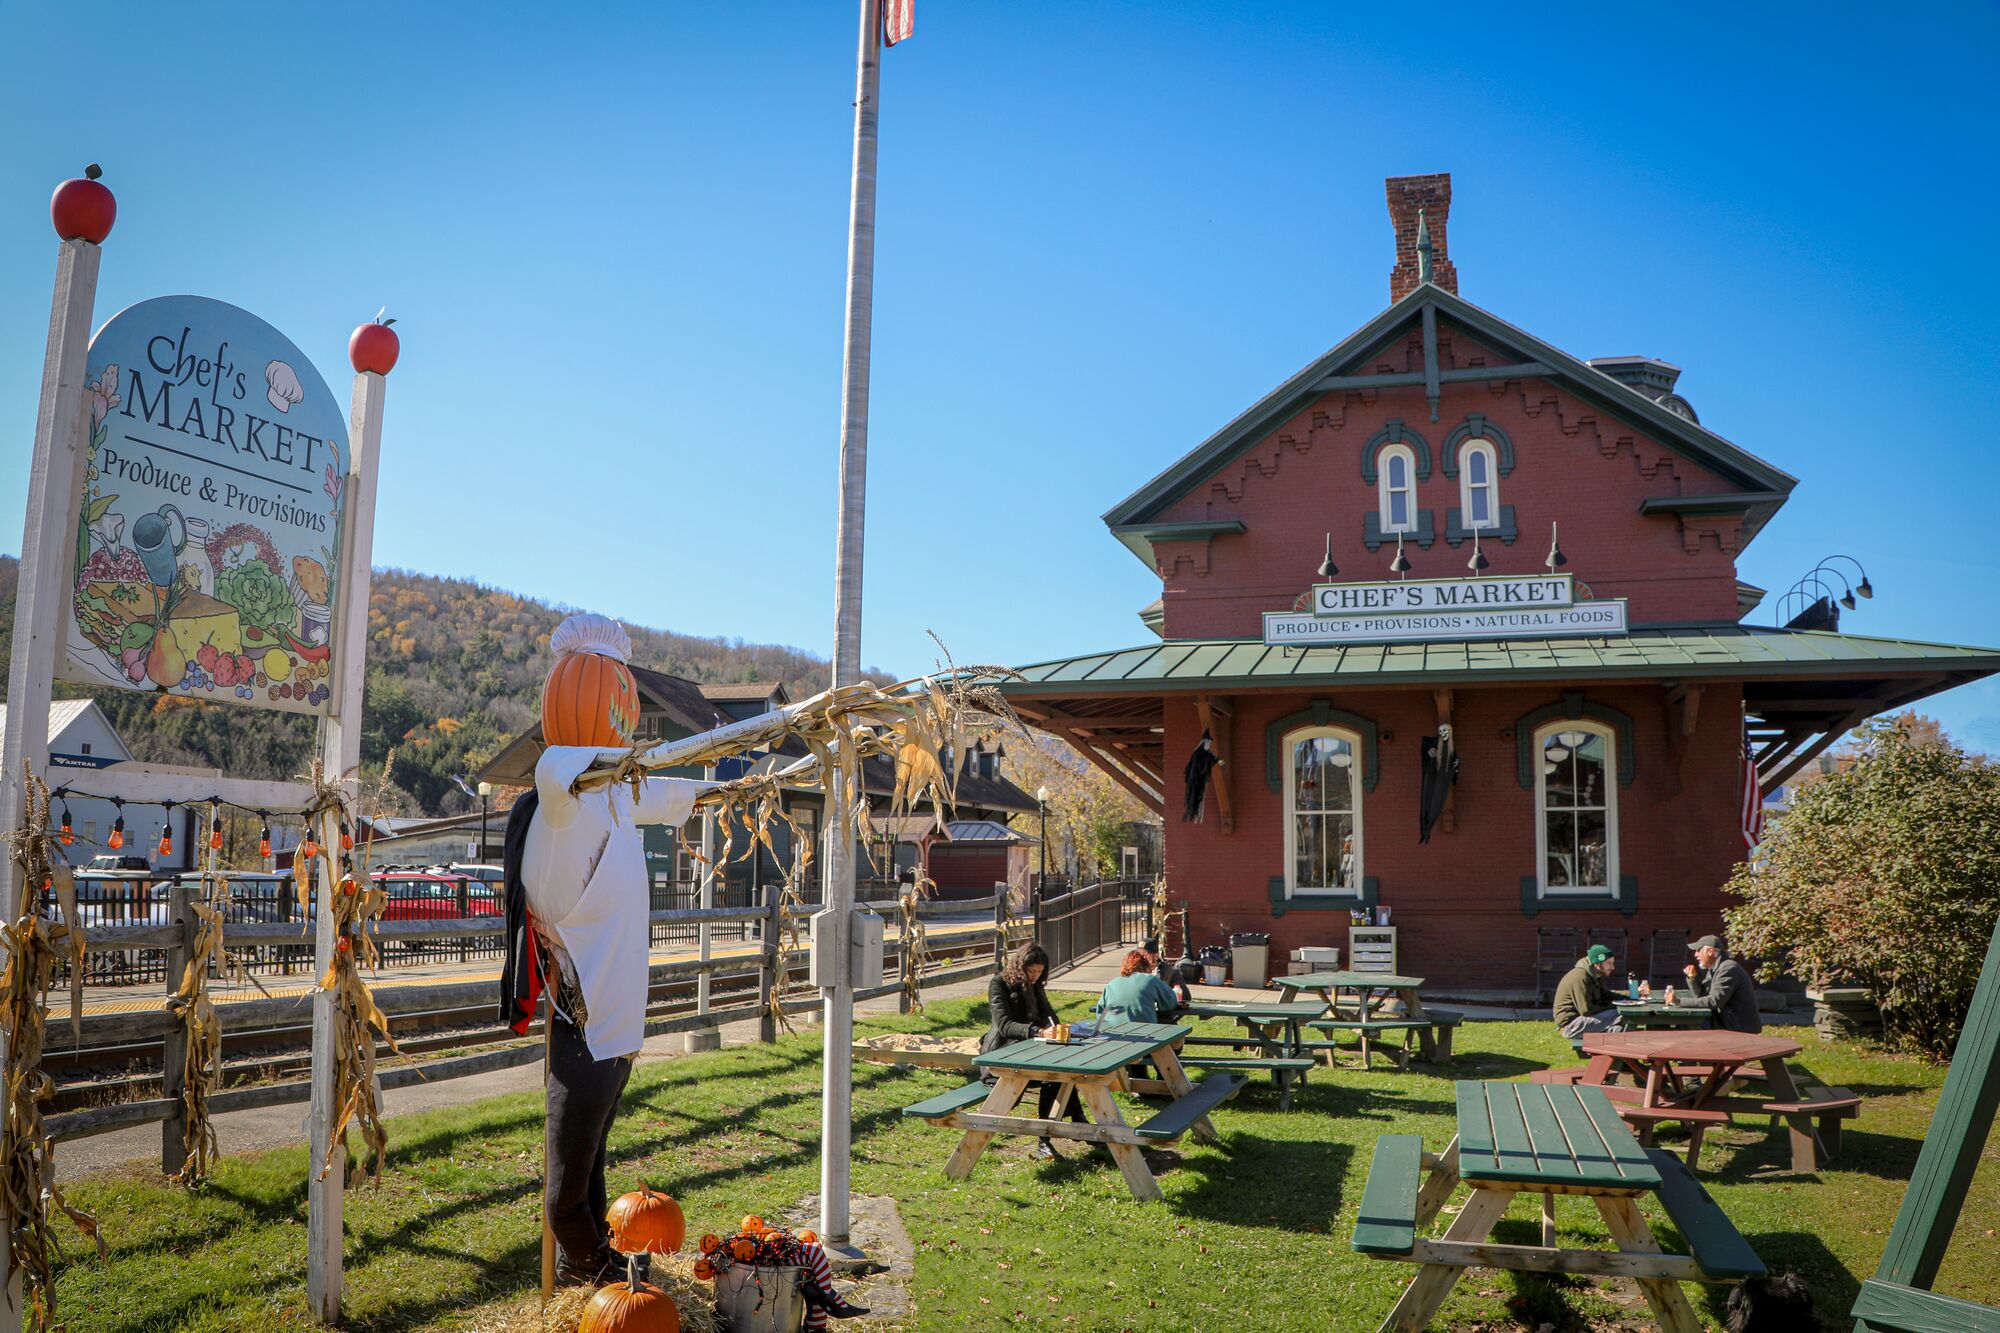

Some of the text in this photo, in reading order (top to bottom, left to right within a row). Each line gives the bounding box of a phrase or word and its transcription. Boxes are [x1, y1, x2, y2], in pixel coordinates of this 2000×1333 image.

[147, 327, 246, 406] Chef's
[120, 368, 322, 473] MARKET
[101, 448, 327, 532] Produce & Provisions
[1276, 611, 1614, 634] PRODUCE PROVISIONS NATURAL FOODS
[1320, 582, 1565, 609] CHEF'S MARKET
